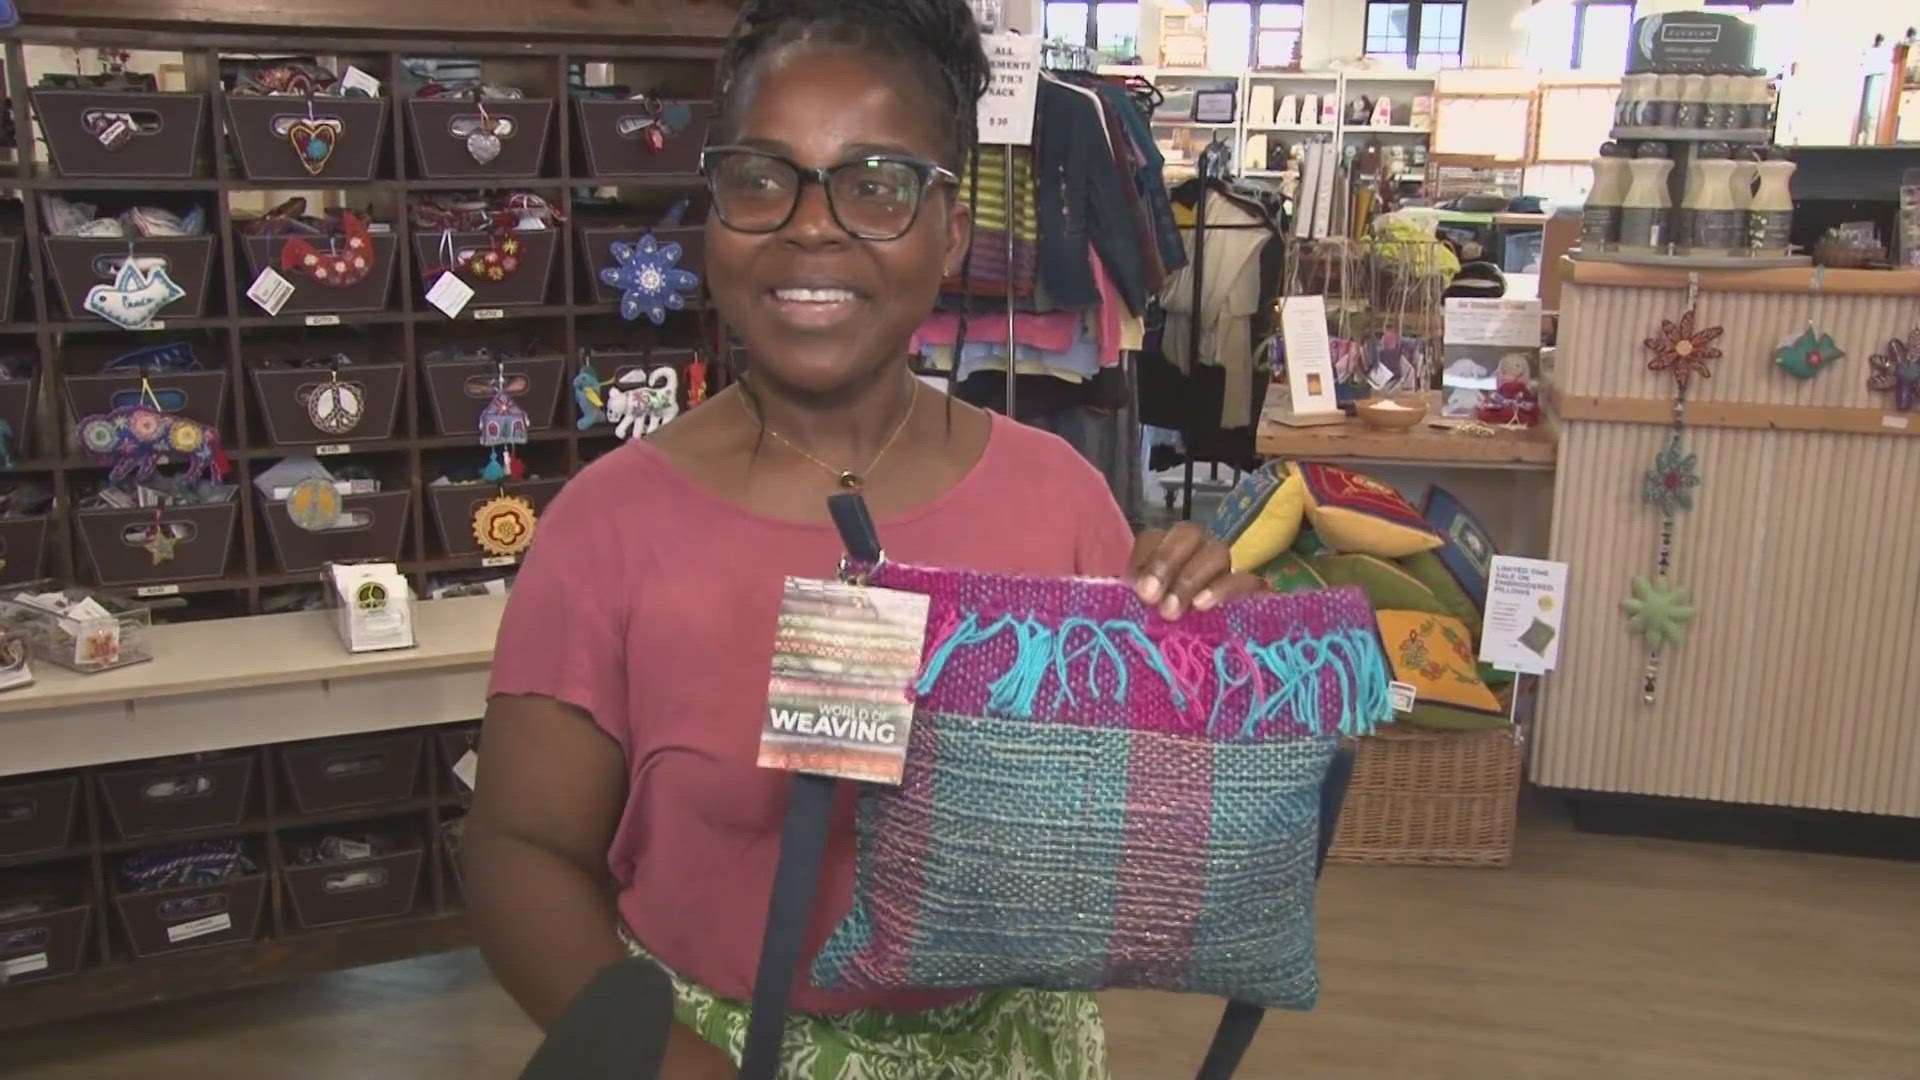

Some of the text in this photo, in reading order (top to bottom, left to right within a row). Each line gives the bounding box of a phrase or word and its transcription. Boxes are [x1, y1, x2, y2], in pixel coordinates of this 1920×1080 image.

[994, 46, 1014, 56] ALL
[818, 703, 888, 723] WORLD OF
[769, 707, 896, 745] WEAVING
